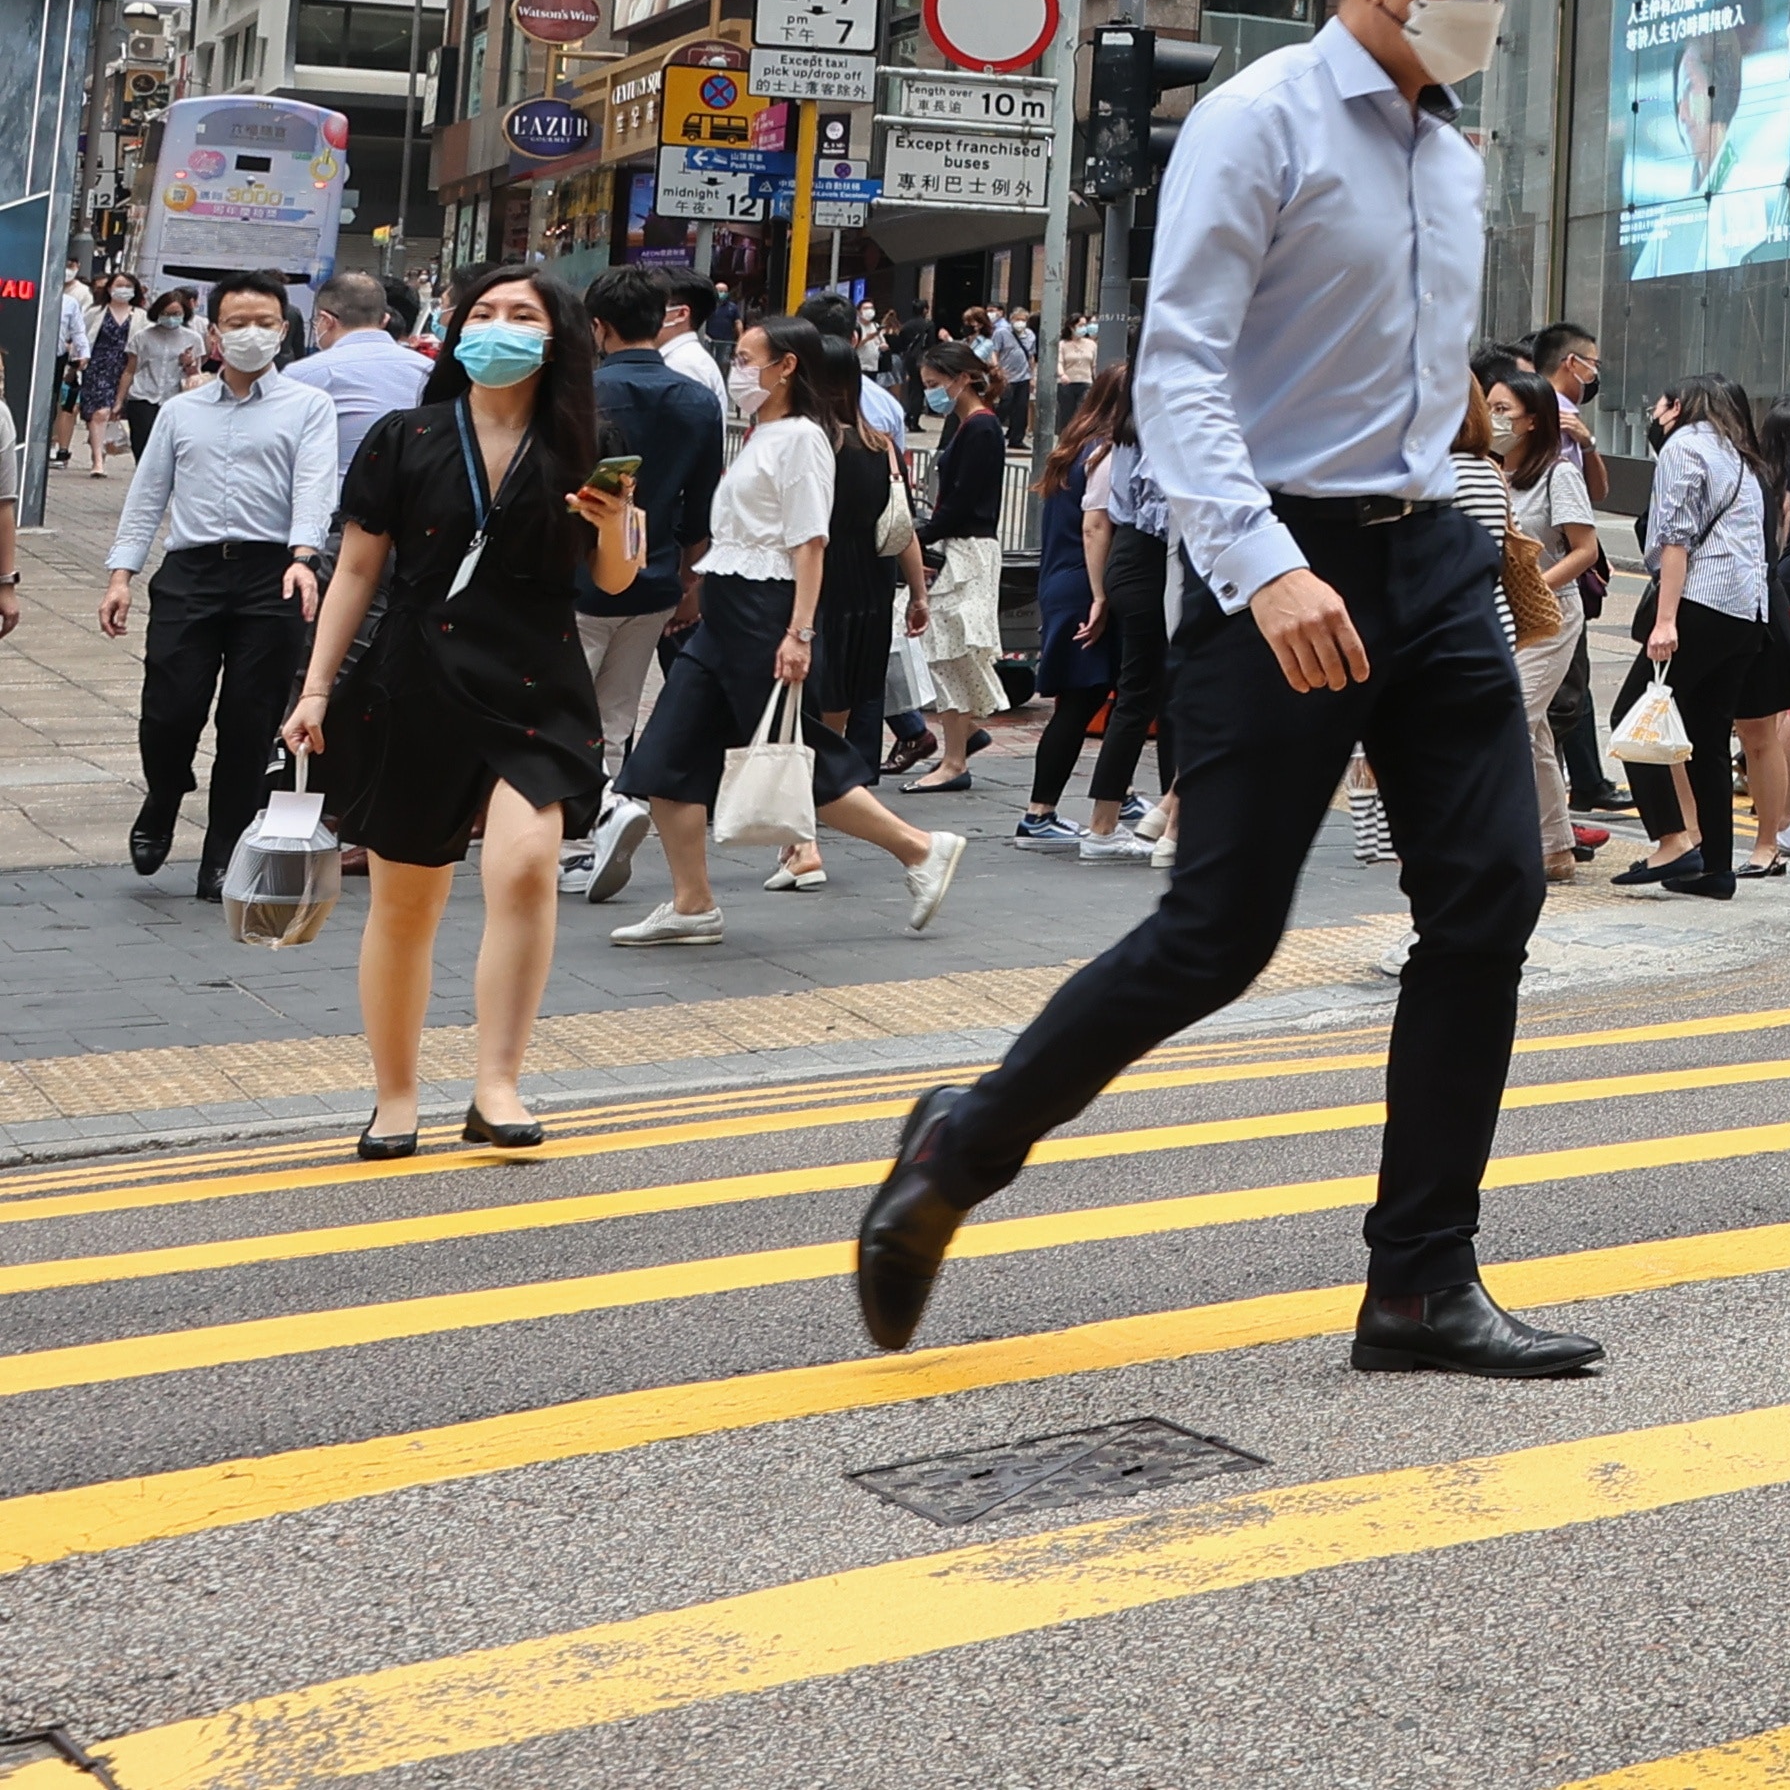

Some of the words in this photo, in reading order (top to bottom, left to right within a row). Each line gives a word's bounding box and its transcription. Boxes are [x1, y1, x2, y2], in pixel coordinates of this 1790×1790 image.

[518, 5, 569, 21] Watson's
[570, 10, 599, 22] Wine
[780, 27, 814, 42] 下午
[787, 15, 808, 25] pm
[835, 19, 854, 44] 7
[780, 54, 822, 68] Except
[825, 57, 848, 68] taxi
[763, 65, 788, 77] pick
[793, 68, 841, 81] up/drop
[844, 70, 862, 80] off
[755, 78, 867, 97] 的士上落客除外
[908, 86, 946, 97] Length
[949, 89, 973, 98] over
[514, 115, 589, 138] L'AZUR
[530, 136, 571, 144] GOURMET
[896, 135, 952, 152] Except
[957, 139, 1041, 157] franchised
[944, 156, 990, 170] buses
[898, 173, 1033, 198] 專利巴士例外
[94, 194, 111, 206] 12
[663, 186, 720, 198] midnight
[727, 193, 757, 216] 12
[675, 200, 710, 214] 午夜
[846, 214, 861, 224] 12
